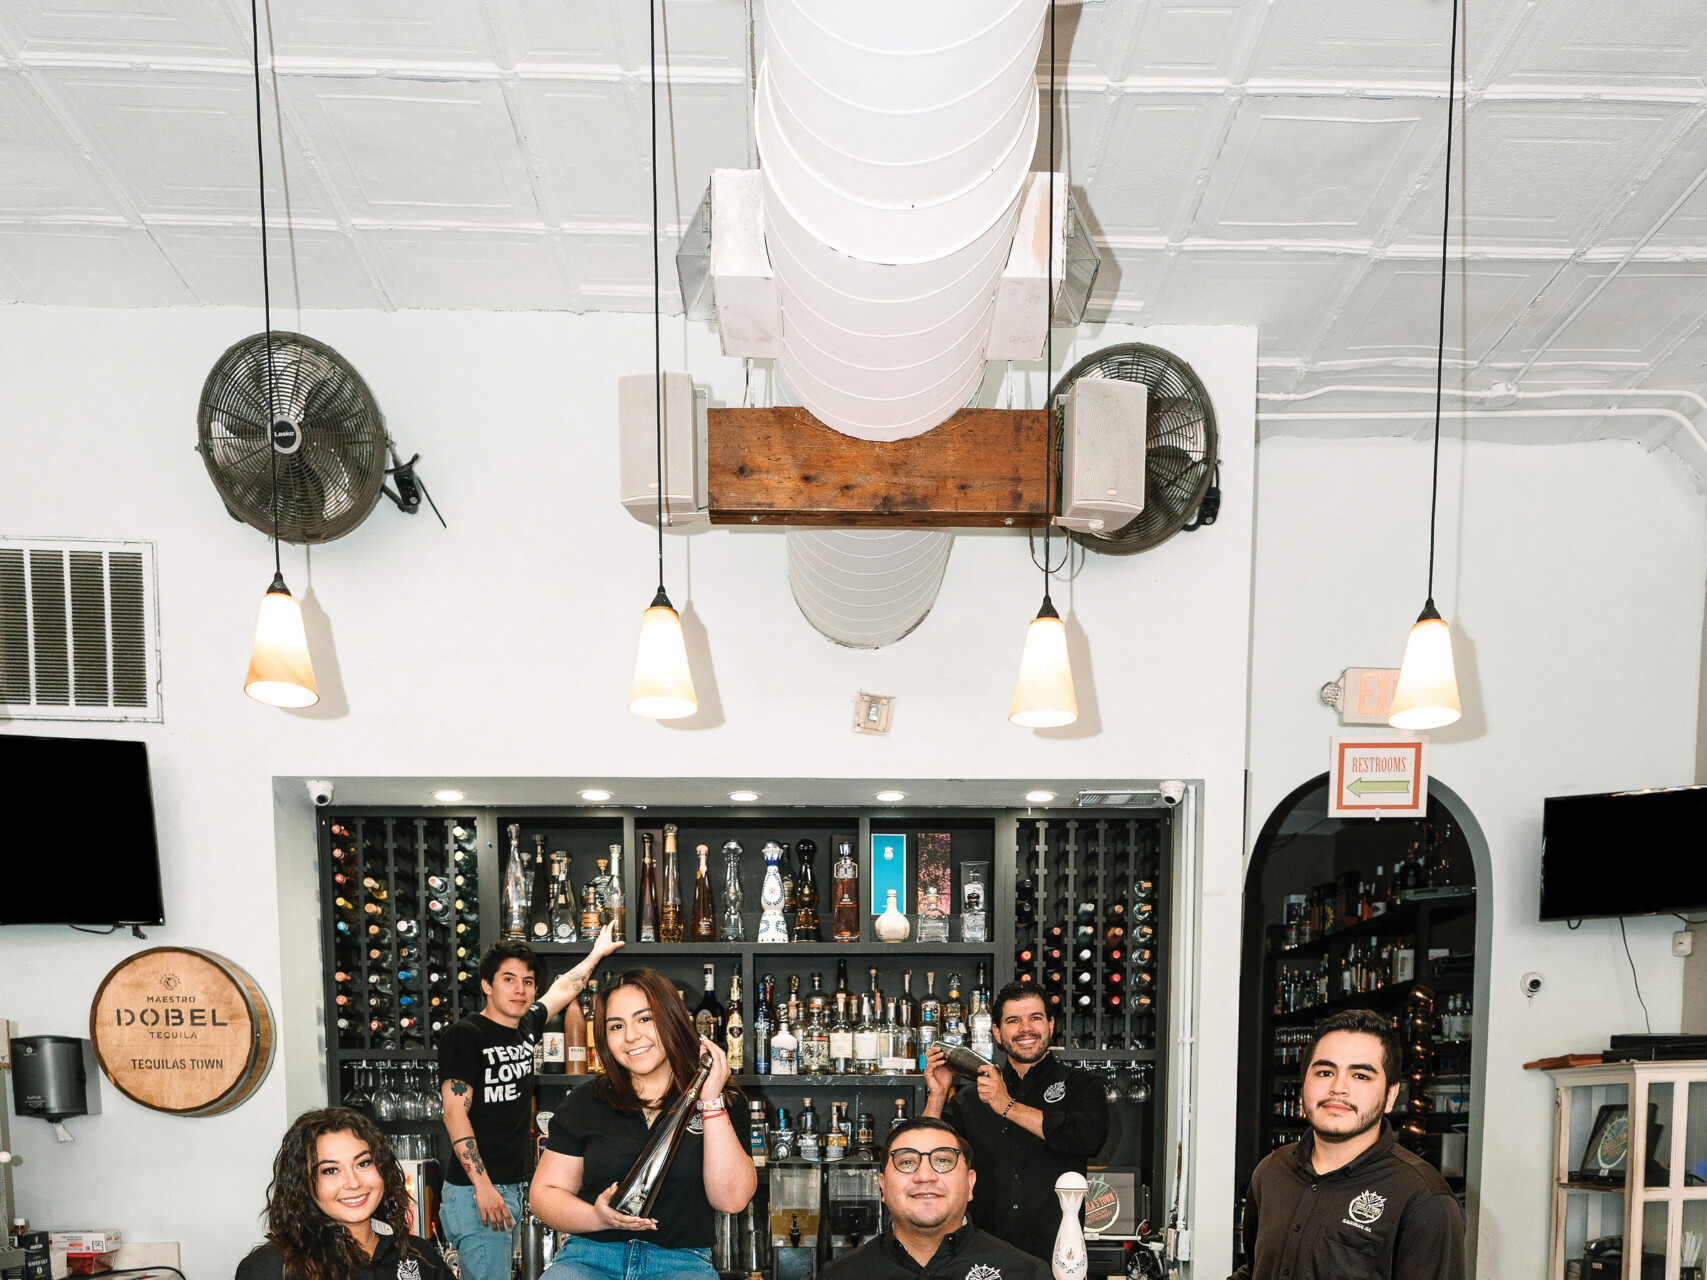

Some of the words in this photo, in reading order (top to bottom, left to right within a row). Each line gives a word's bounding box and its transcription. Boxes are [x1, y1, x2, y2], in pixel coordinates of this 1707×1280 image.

[1352, 757, 1406, 772] RESTROOMS
[116, 1008, 228, 1027] DOBEL
[149, 1031, 198, 1039] TEQUILA
[131, 1059, 187, 1070] TEQUILAS
[189, 1059, 224, 1070] TOWN
